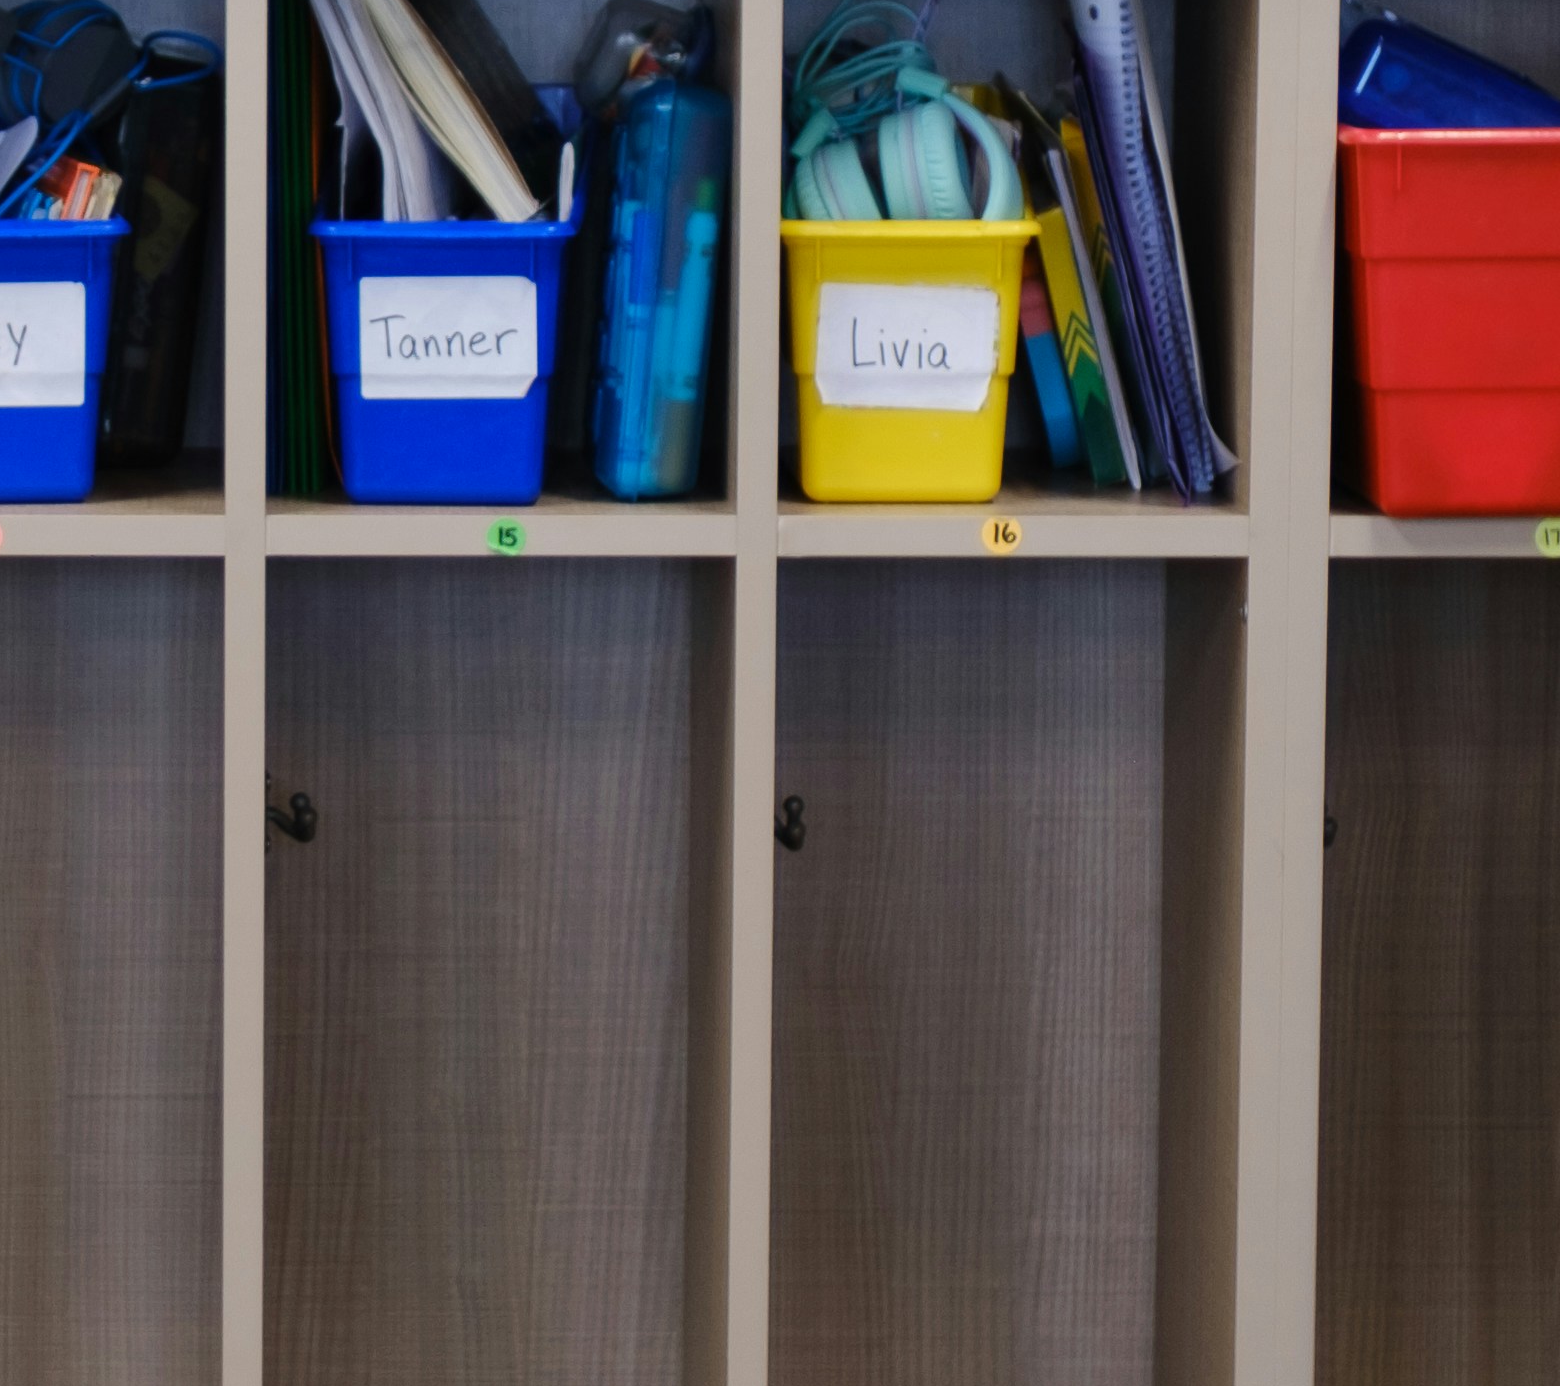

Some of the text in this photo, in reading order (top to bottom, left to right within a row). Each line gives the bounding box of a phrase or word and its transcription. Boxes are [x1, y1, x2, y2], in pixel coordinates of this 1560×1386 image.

[370, 314, 521, 361] Tanner
[851, 321, 952, 372] Livia
[495, 526, 519, 549] 15
[990, 524, 1018, 547] 16
